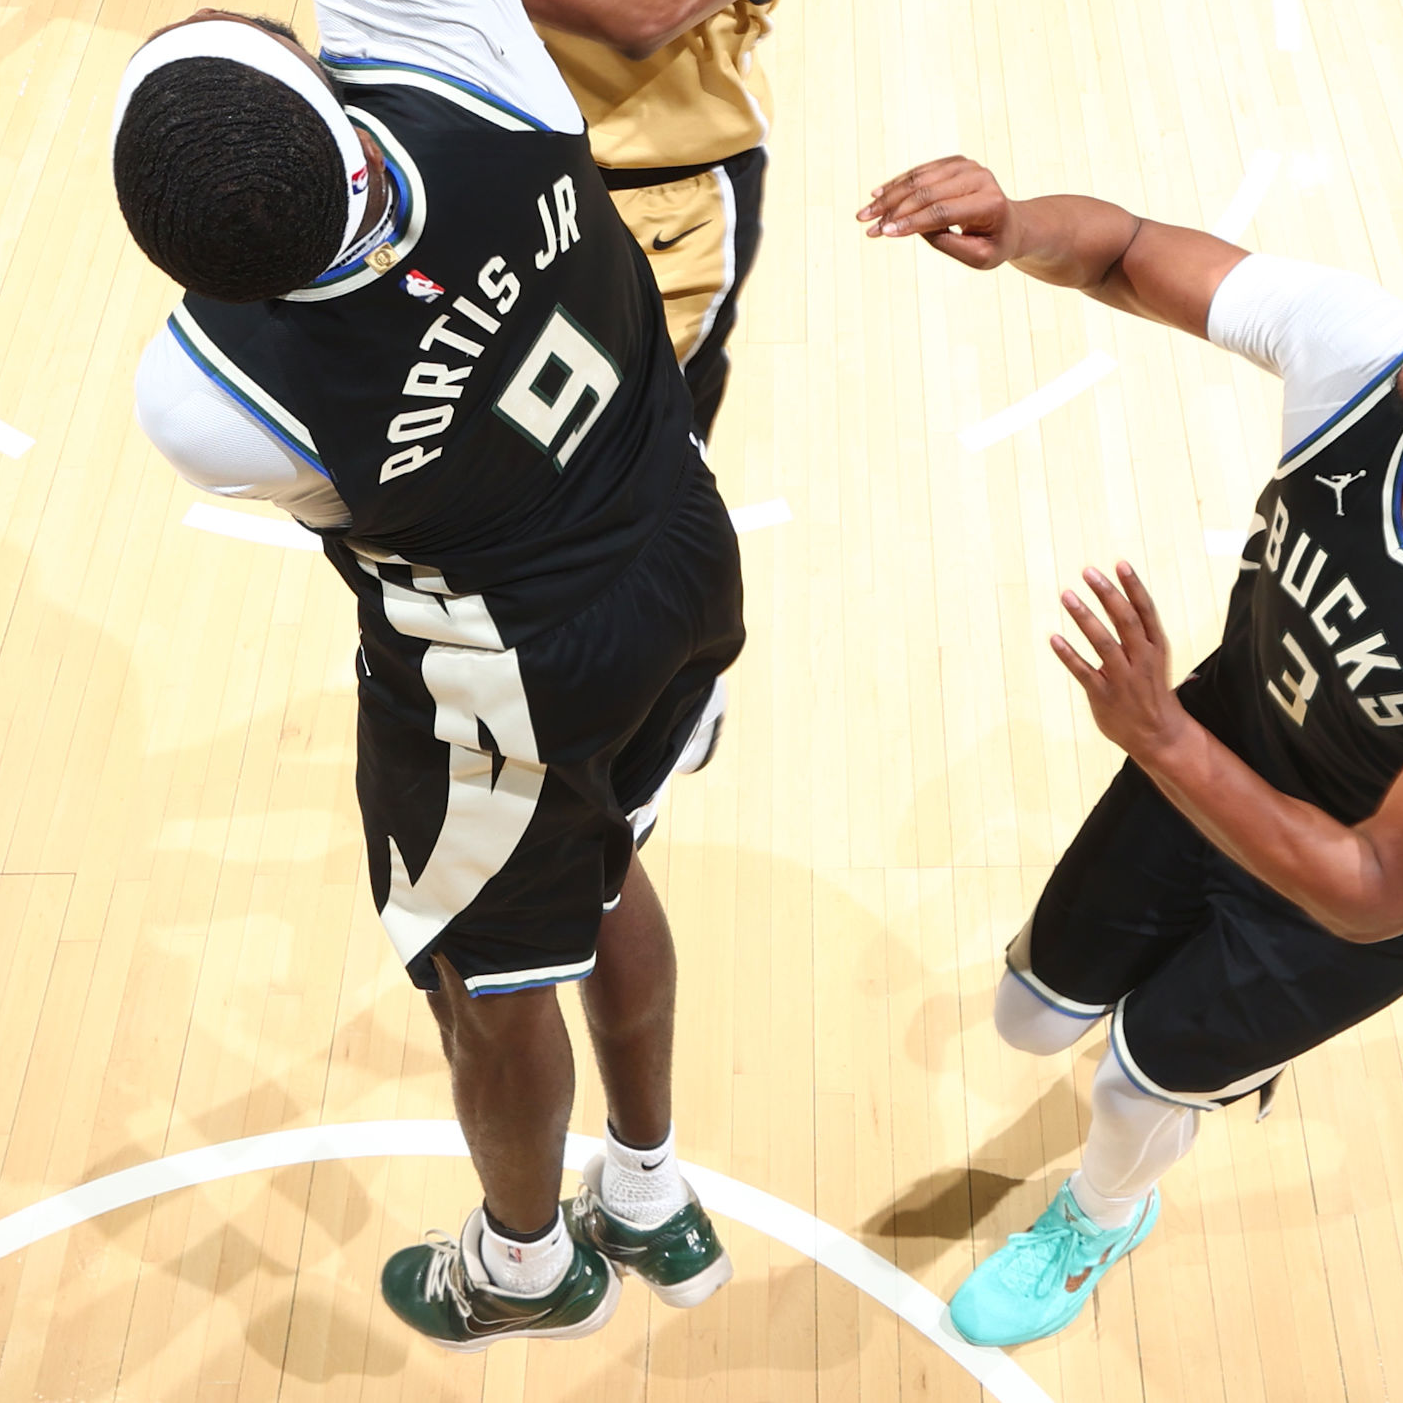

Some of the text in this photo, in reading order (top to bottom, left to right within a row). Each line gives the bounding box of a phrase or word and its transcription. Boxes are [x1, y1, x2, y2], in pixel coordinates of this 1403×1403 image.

[378, 174, 581, 485] PORTIS JR
[491, 302, 624, 475] 9
[1266, 631, 1322, 728] 3
